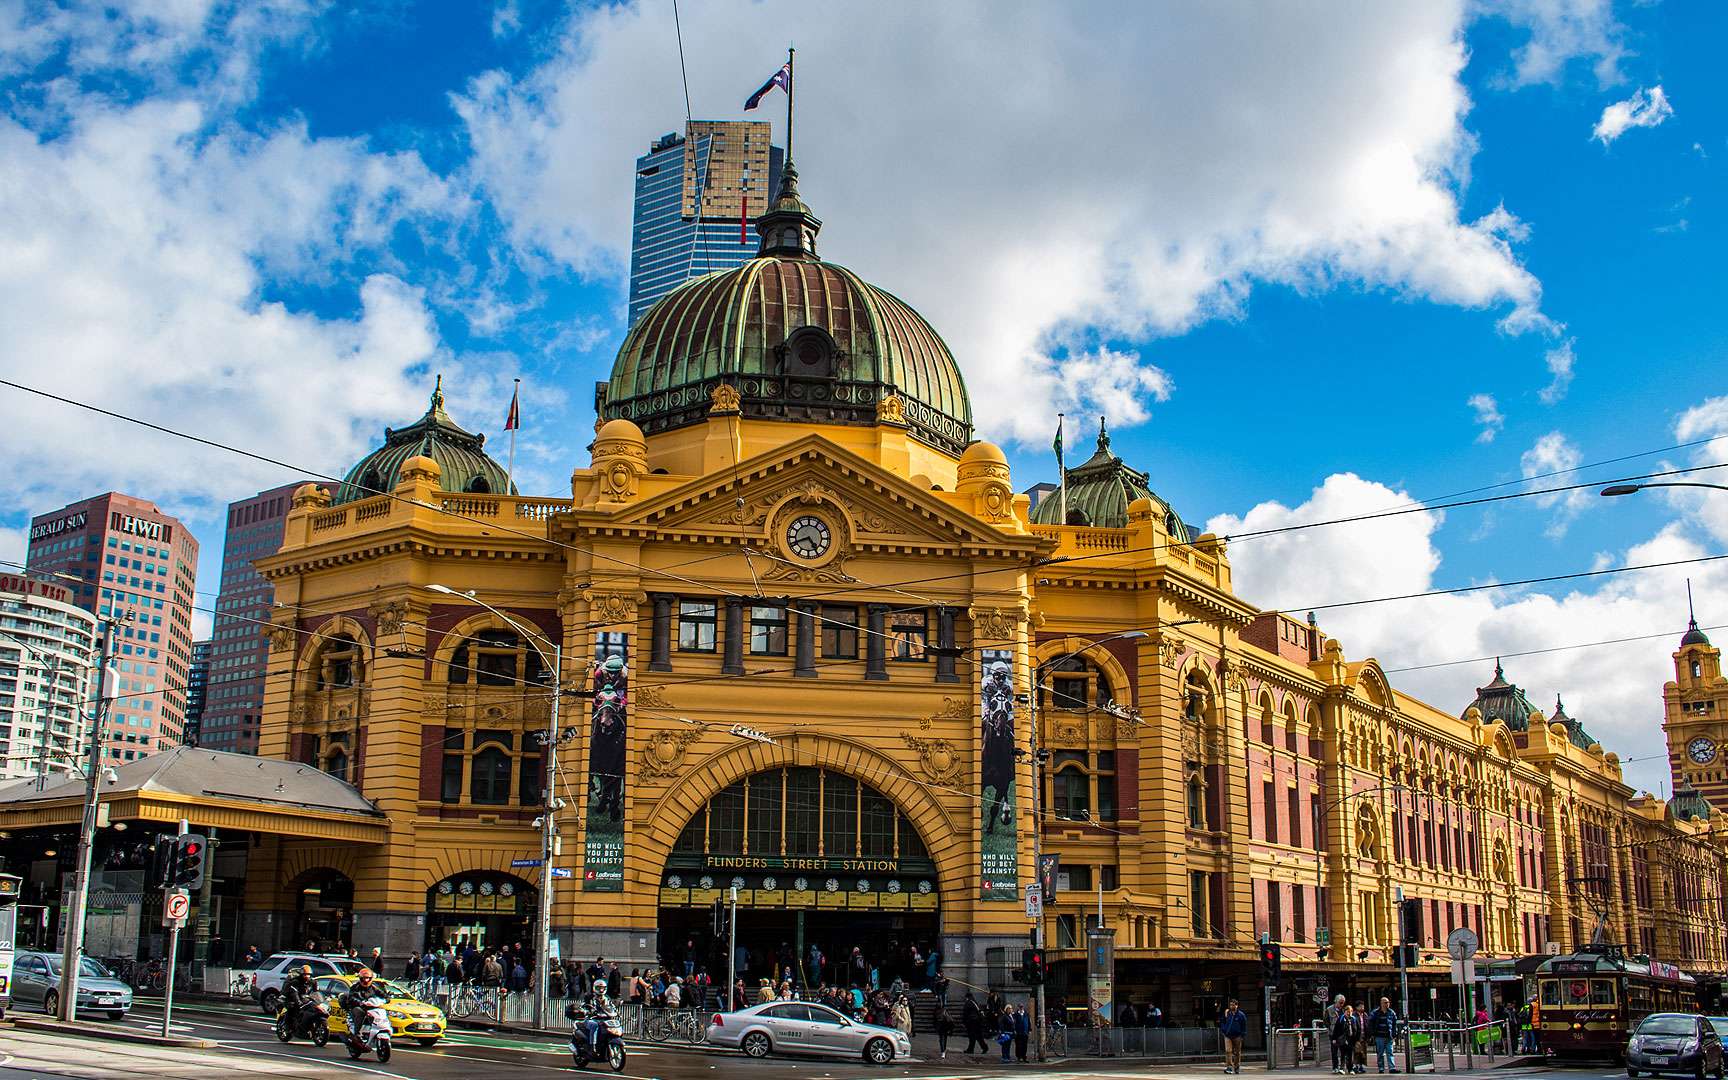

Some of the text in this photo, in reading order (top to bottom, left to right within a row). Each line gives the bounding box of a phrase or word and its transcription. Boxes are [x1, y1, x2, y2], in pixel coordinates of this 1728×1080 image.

[66, 513, 87, 529] SUN
[124, 515, 161, 539] HWT
[1, 576, 66, 602] QUAY WEST
[604, 842, 622, 850] WILL
[707, 856, 897, 871] FLINDERS STREET STATION
[1608, 947, 1620, 957] 35
